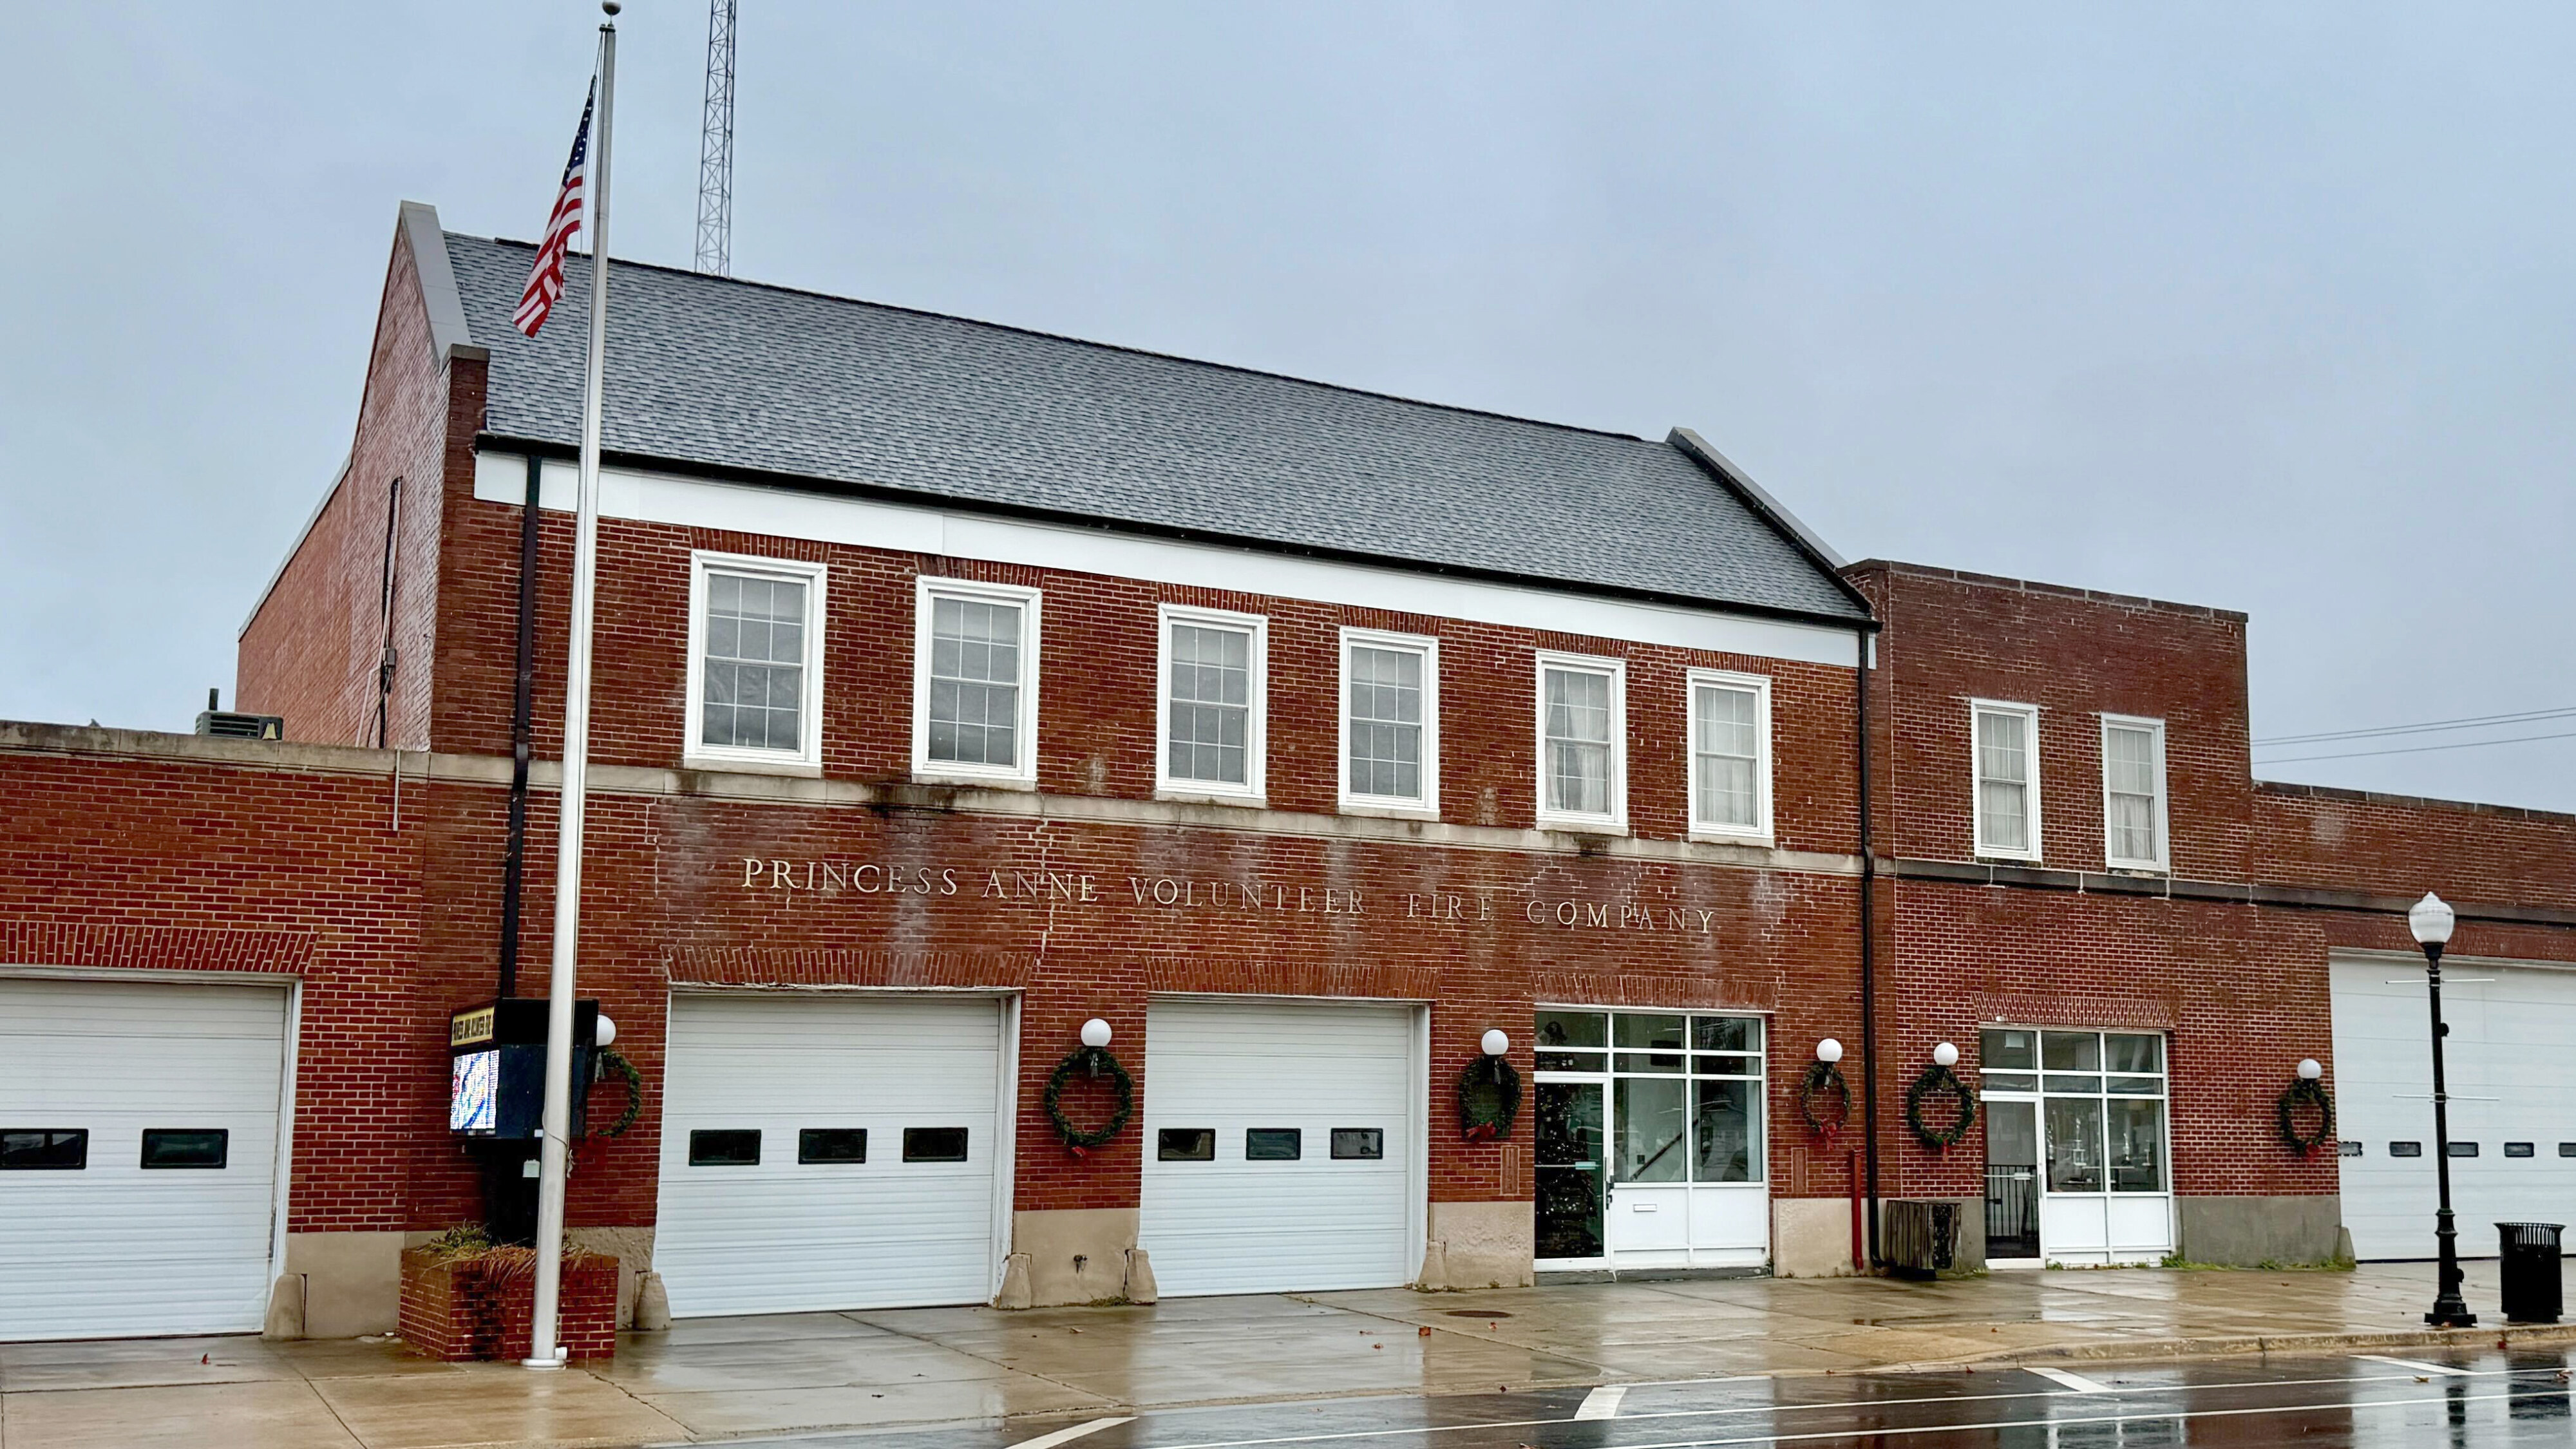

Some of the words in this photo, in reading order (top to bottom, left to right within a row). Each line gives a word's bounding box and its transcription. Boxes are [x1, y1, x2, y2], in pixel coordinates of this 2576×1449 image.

[742, 857, 957, 896] PRINCESS
[983, 869, 1099, 902] ANNE
[1129, 877, 1366, 914] VOLUNTEER
[1407, 893, 1495, 921] FIRE
[1527, 900, 1714, 934] COMPANY
